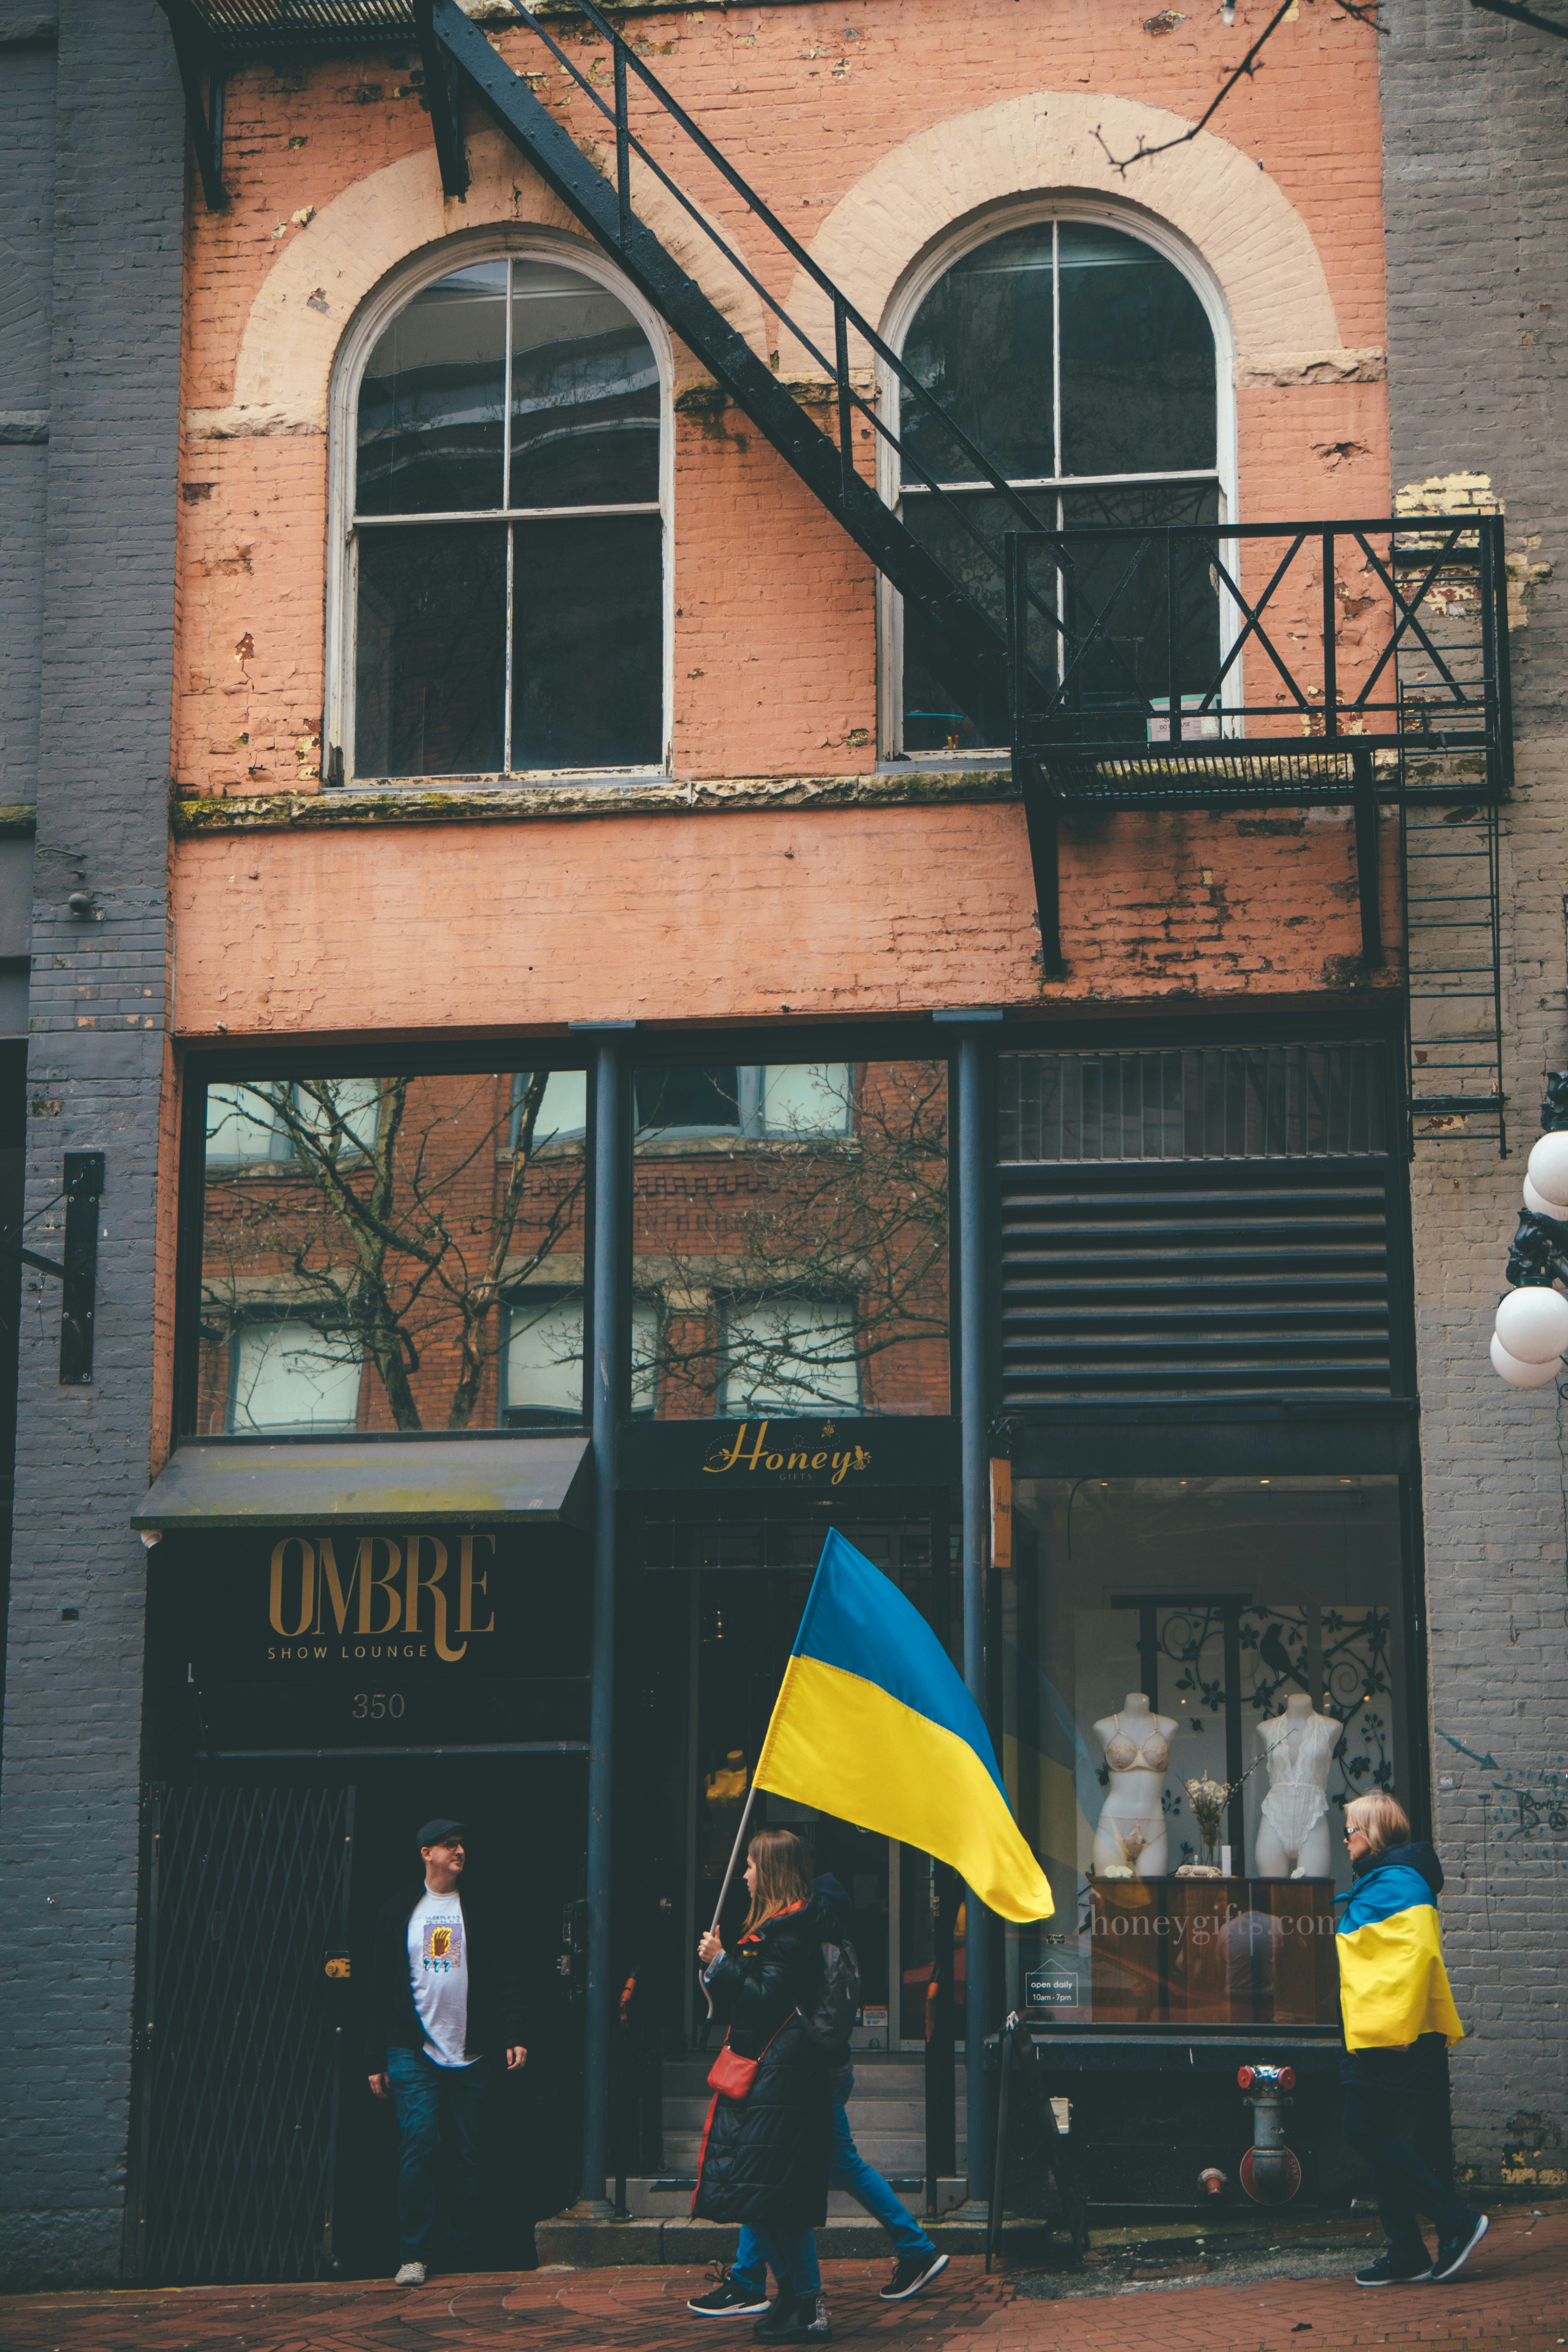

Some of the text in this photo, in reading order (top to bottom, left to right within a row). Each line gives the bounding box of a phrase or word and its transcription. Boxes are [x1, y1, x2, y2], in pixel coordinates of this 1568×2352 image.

[703, 1420, 859, 1485] Honey
[268, 1645, 426, 1658] SHOW LOUNGE
[353, 1694, 404, 1718] 350
[424, 1959, 452, 1972] 777
[1053, 1980, 1072, 1989] daily
[1056, 1994, 1071, 2002] 7pm
